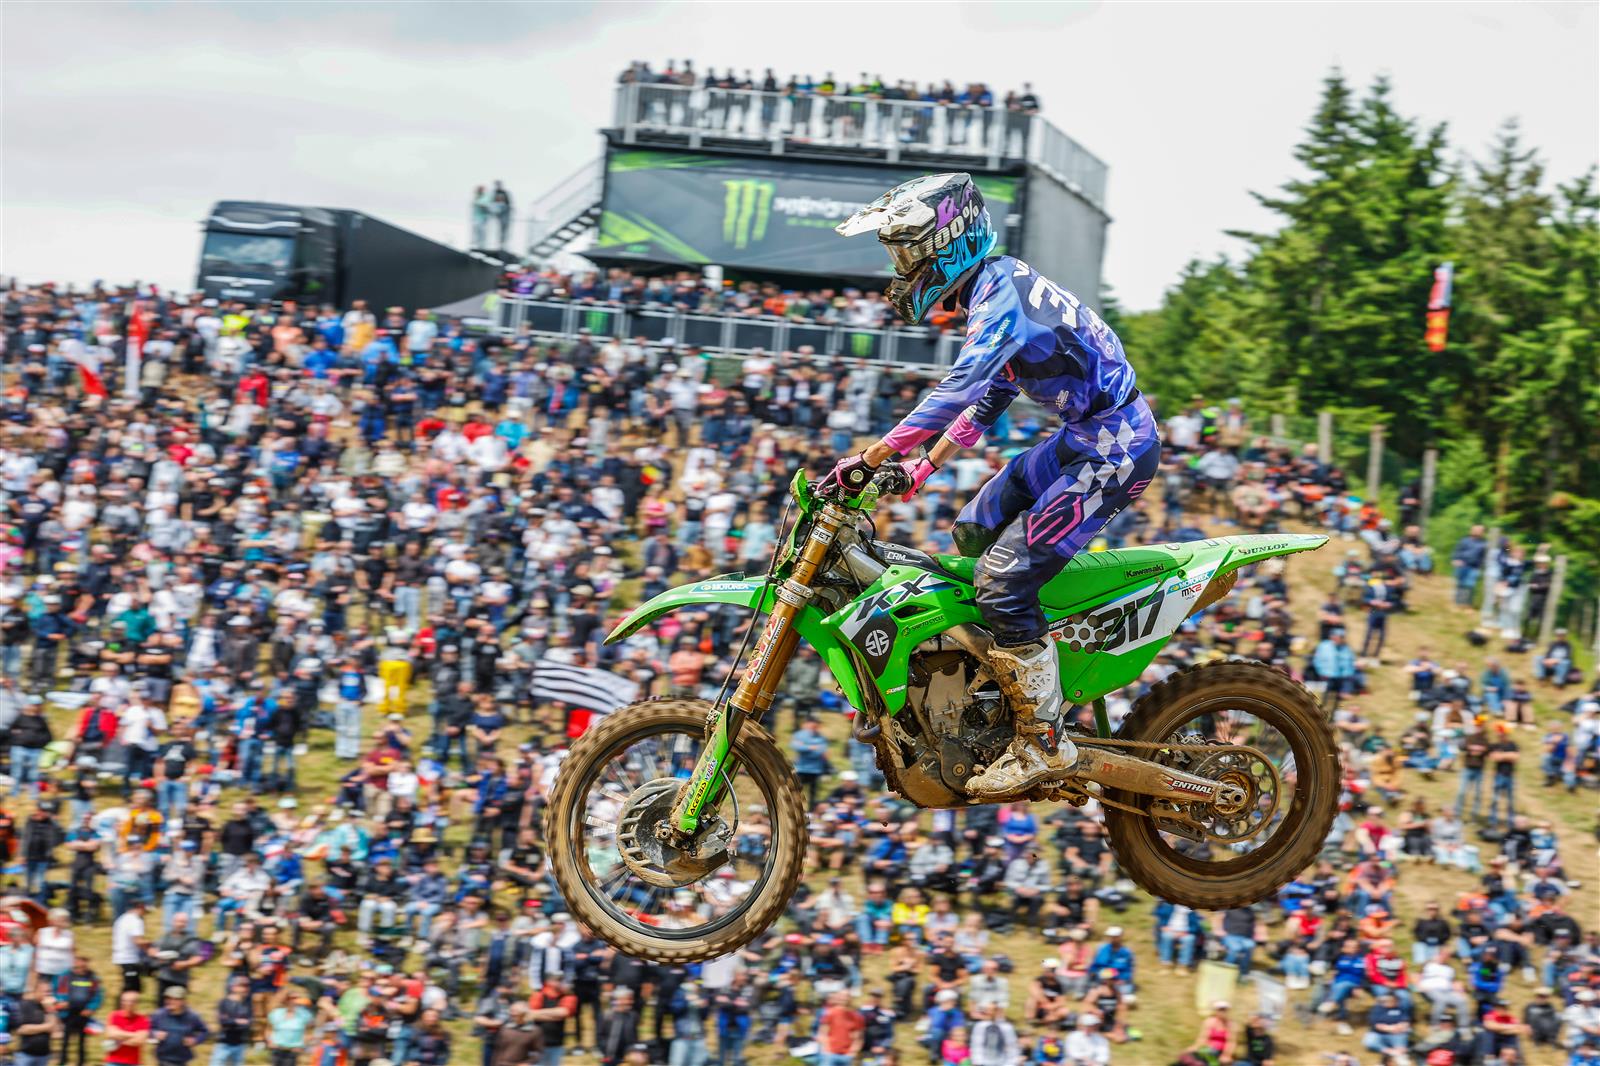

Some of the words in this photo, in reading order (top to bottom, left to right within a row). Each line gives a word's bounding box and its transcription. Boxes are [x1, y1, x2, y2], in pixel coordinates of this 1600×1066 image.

[922, 199, 979, 256] 100%
[1246, 543, 1288, 554] DUNLOP
[1125, 563, 1164, 578] Kawasaki
[855, 572, 932, 623] KX
[1089, 589, 1165, 651] 317
[689, 781, 707, 816] ACERBIS
